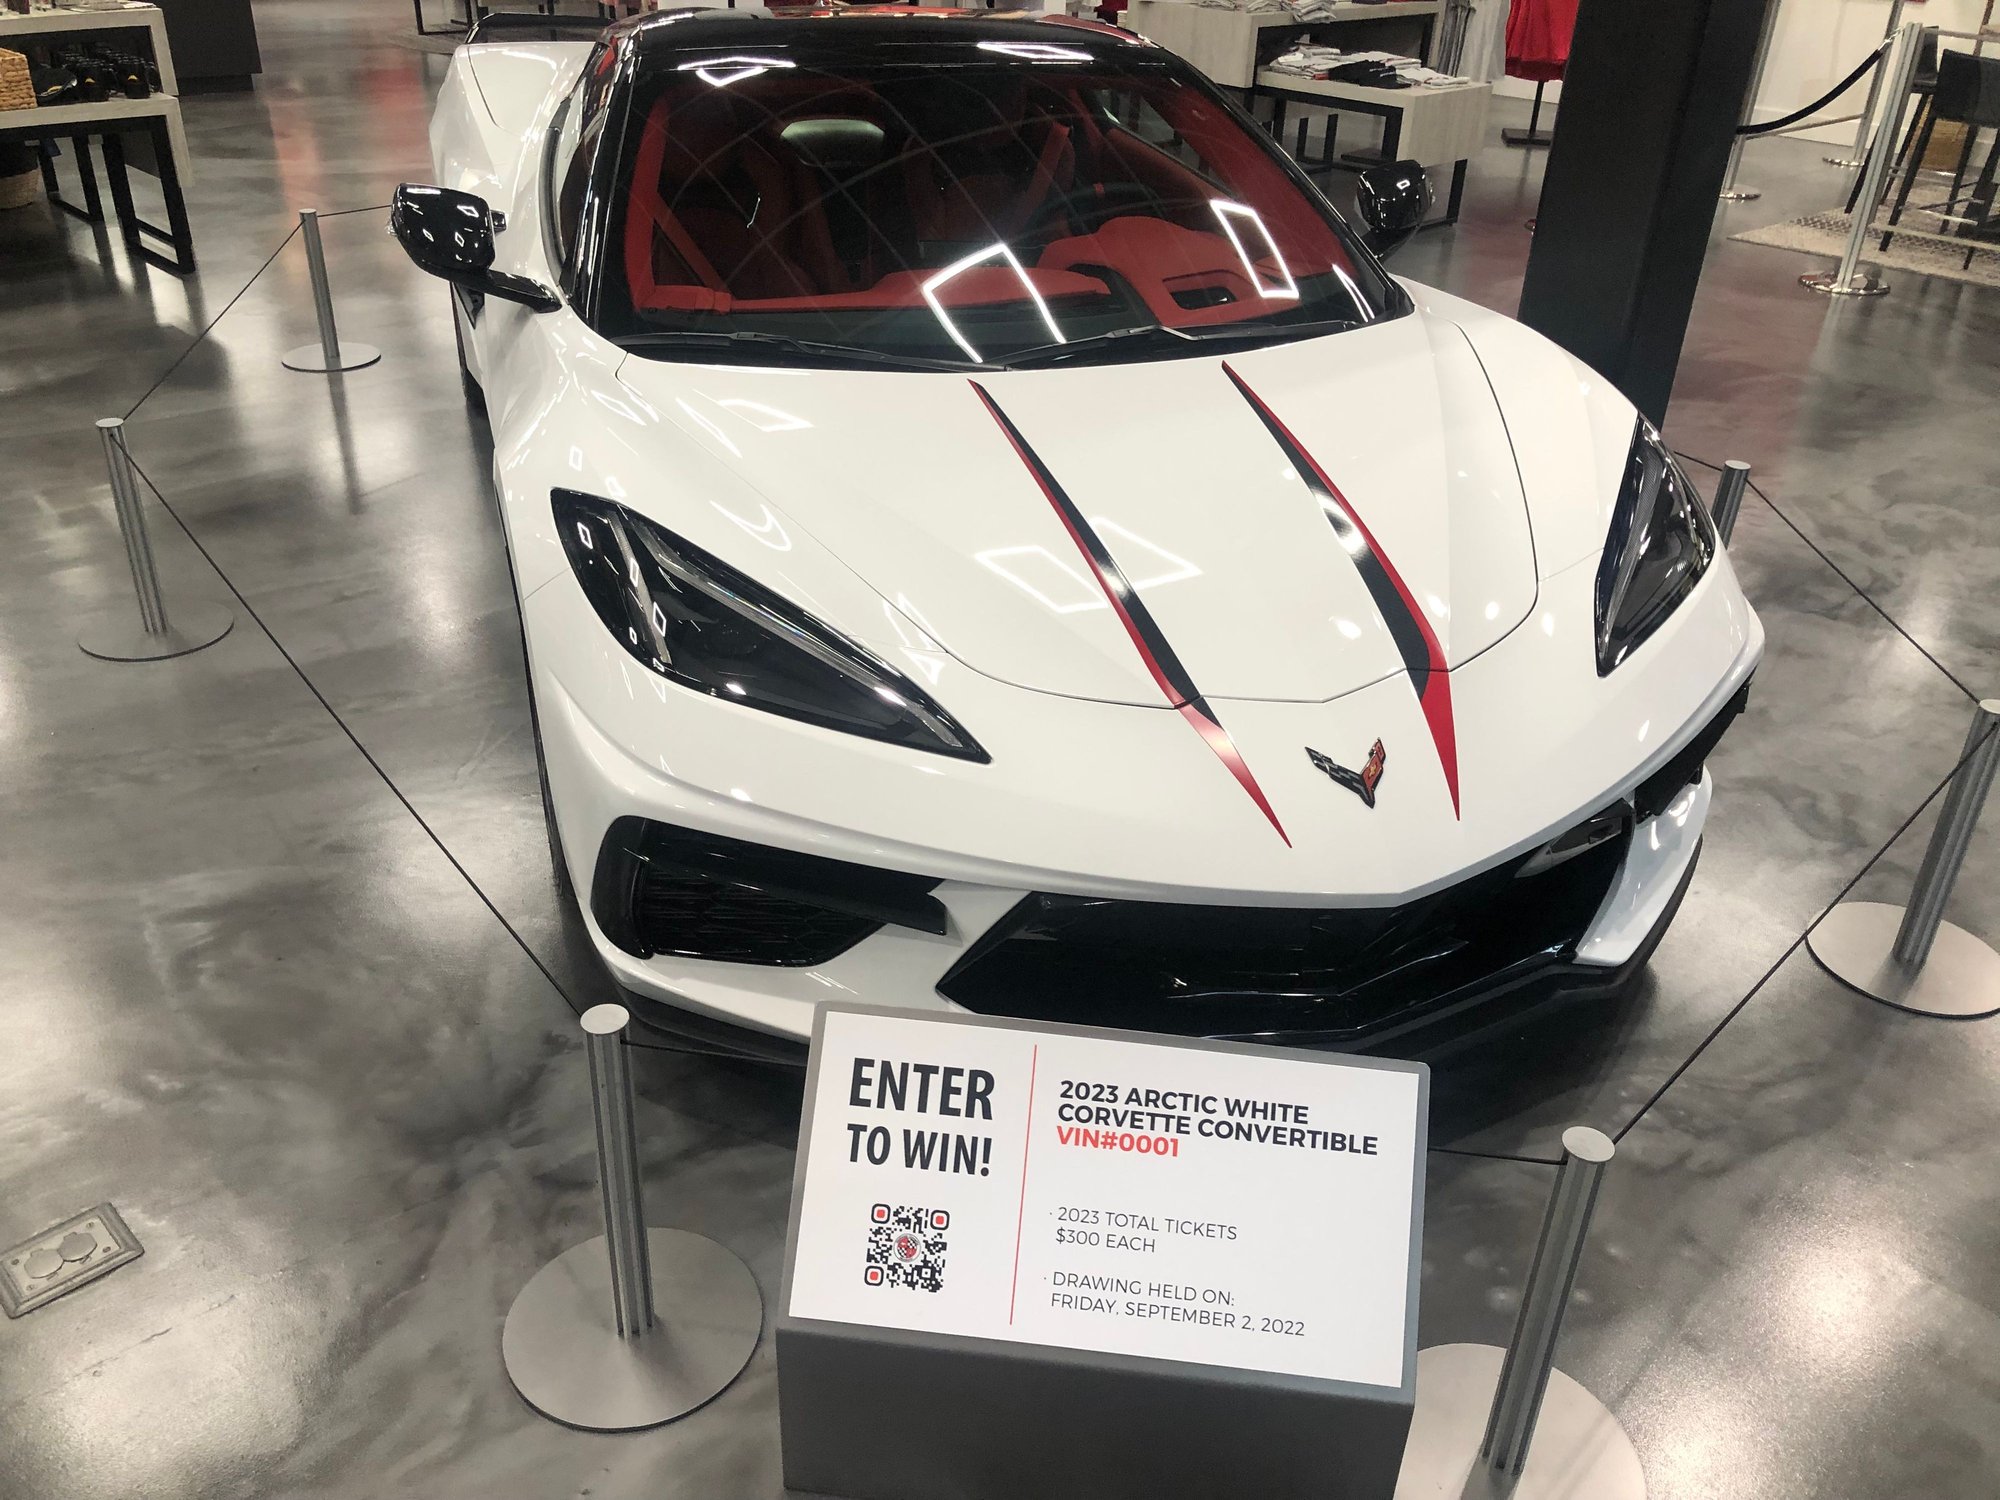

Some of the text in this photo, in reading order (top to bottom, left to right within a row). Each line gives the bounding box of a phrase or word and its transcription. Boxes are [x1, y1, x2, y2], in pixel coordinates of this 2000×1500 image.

[848, 1056, 996, 1121] ENTER
[1059, 1079, 1310, 1125] 2023 ARCTIC WHITE
[846, 1122, 993, 1178] TO WIN!
[1056, 1125, 1179, 1158] VIN#0001
[1057, 1102, 1379, 1156] CORVETTE CONVERTIBLE
[1055, 1226, 1156, 1254] $300 EACH
[1057, 1206, 1238, 1241] 2023 TOTAL TICKETS
[1052, 1271, 1235, 1307] DRAWING HELD ON:
[1051, 1292, 1305, 1337] FRIDAY, SEPTEMBER 2, 2022
